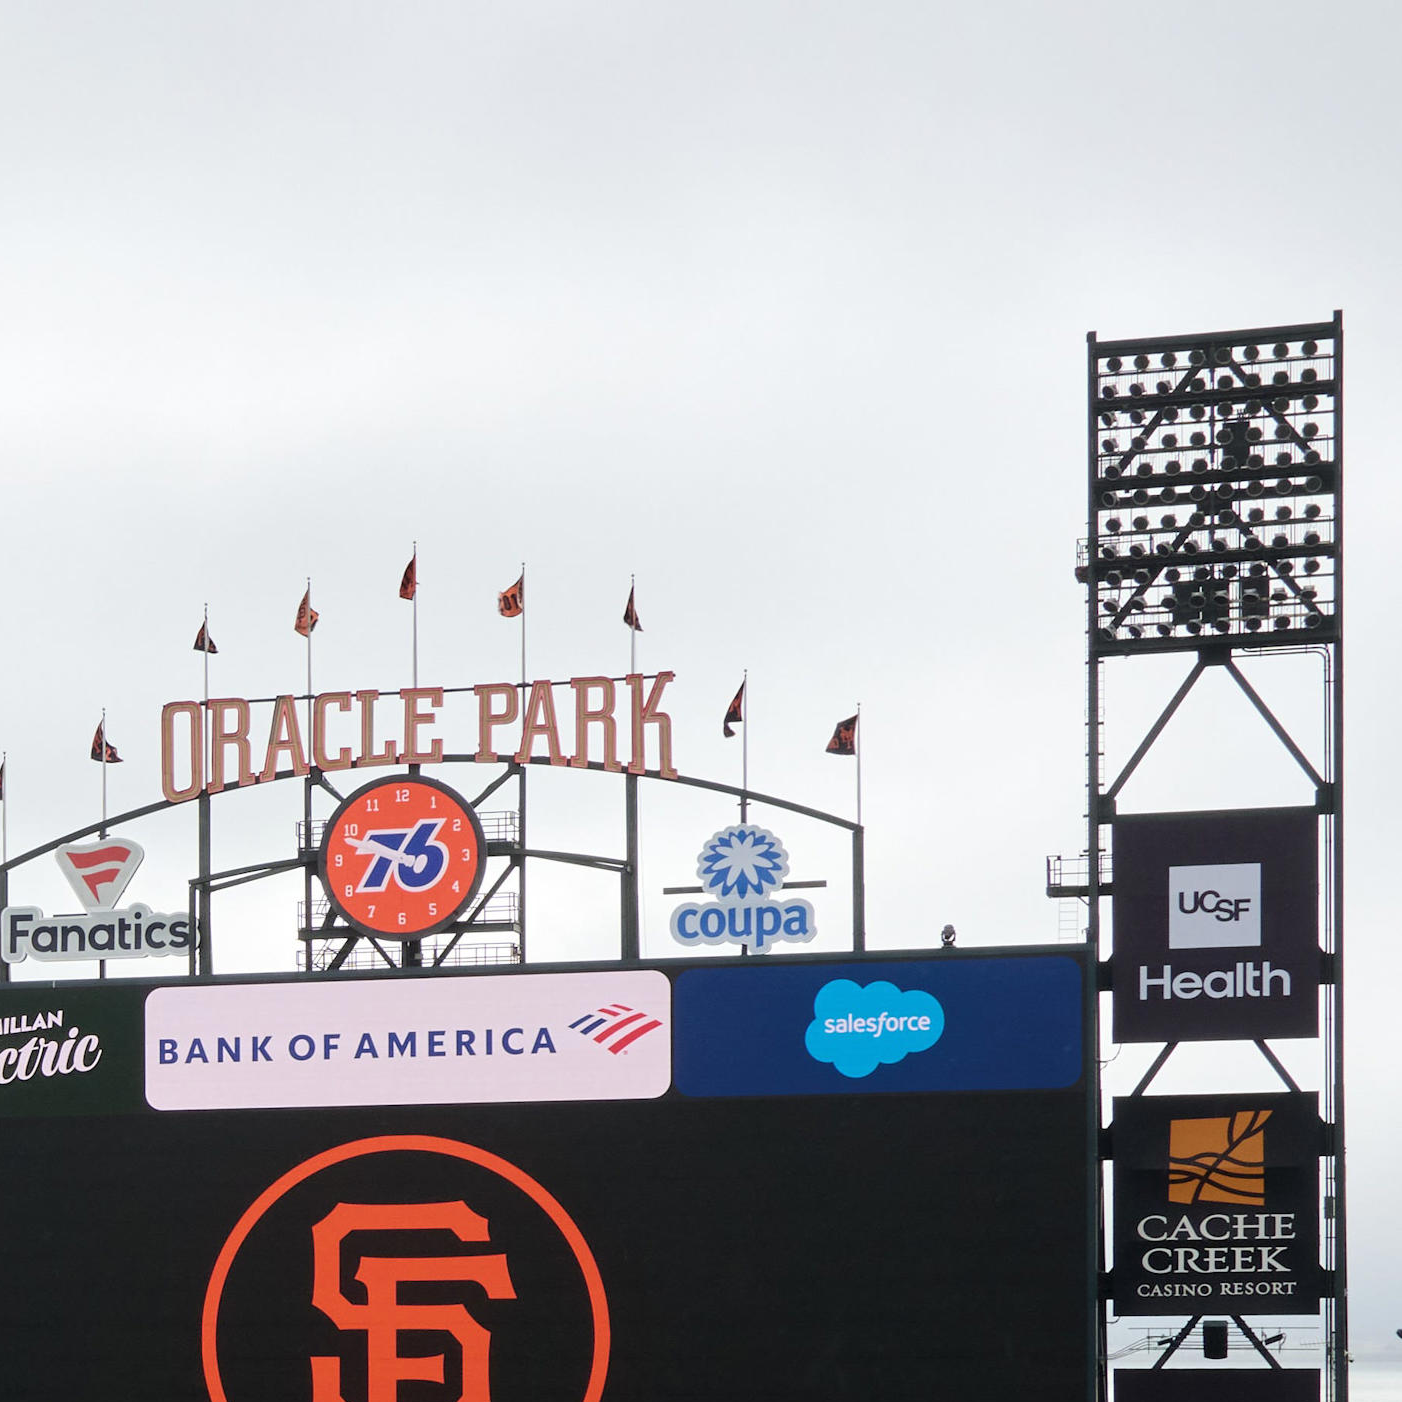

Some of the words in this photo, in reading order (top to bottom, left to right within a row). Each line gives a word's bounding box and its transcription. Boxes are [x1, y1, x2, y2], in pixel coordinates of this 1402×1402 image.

[161, 687, 444, 803] ORACLE
[474, 670, 679, 780] PARK
[396, 789, 410, 802] 12
[430, 796, 437, 808] 1
[366, 799, 379, 812] 11
[344, 824, 358, 837] 10
[452, 818, 462, 832] 2
[334, 854, 344, 867] 9
[355, 818, 449, 893] 76
[461, 849, 470, 862] 3
[345, 885, 353, 897] 8
[452, 880, 460, 893] 4
[367, 905, 376, 918] 7
[428, 903, 437, 916] 5
[1178, 889, 1251, 922] UCSF
[398, 913, 407, 926] 6
[677, 903, 809, 949] coupa
[9, 911, 192, 954] Fanatics
[1139, 961, 1291, 1001] Health
[824, 1012, 931, 1038] salesforce
[159, 1035, 273, 1065] BANK
[289, 1033, 341, 1062] OF
[354, 1027, 557, 1059] AMERICA
[1137, 1213, 1296, 1242] CACHE
[1142, 1246, 1292, 1274] CREEK
[1137, 1283, 1213, 1297] CASINO
[1220, 1281, 1297, 1296] RESORT
